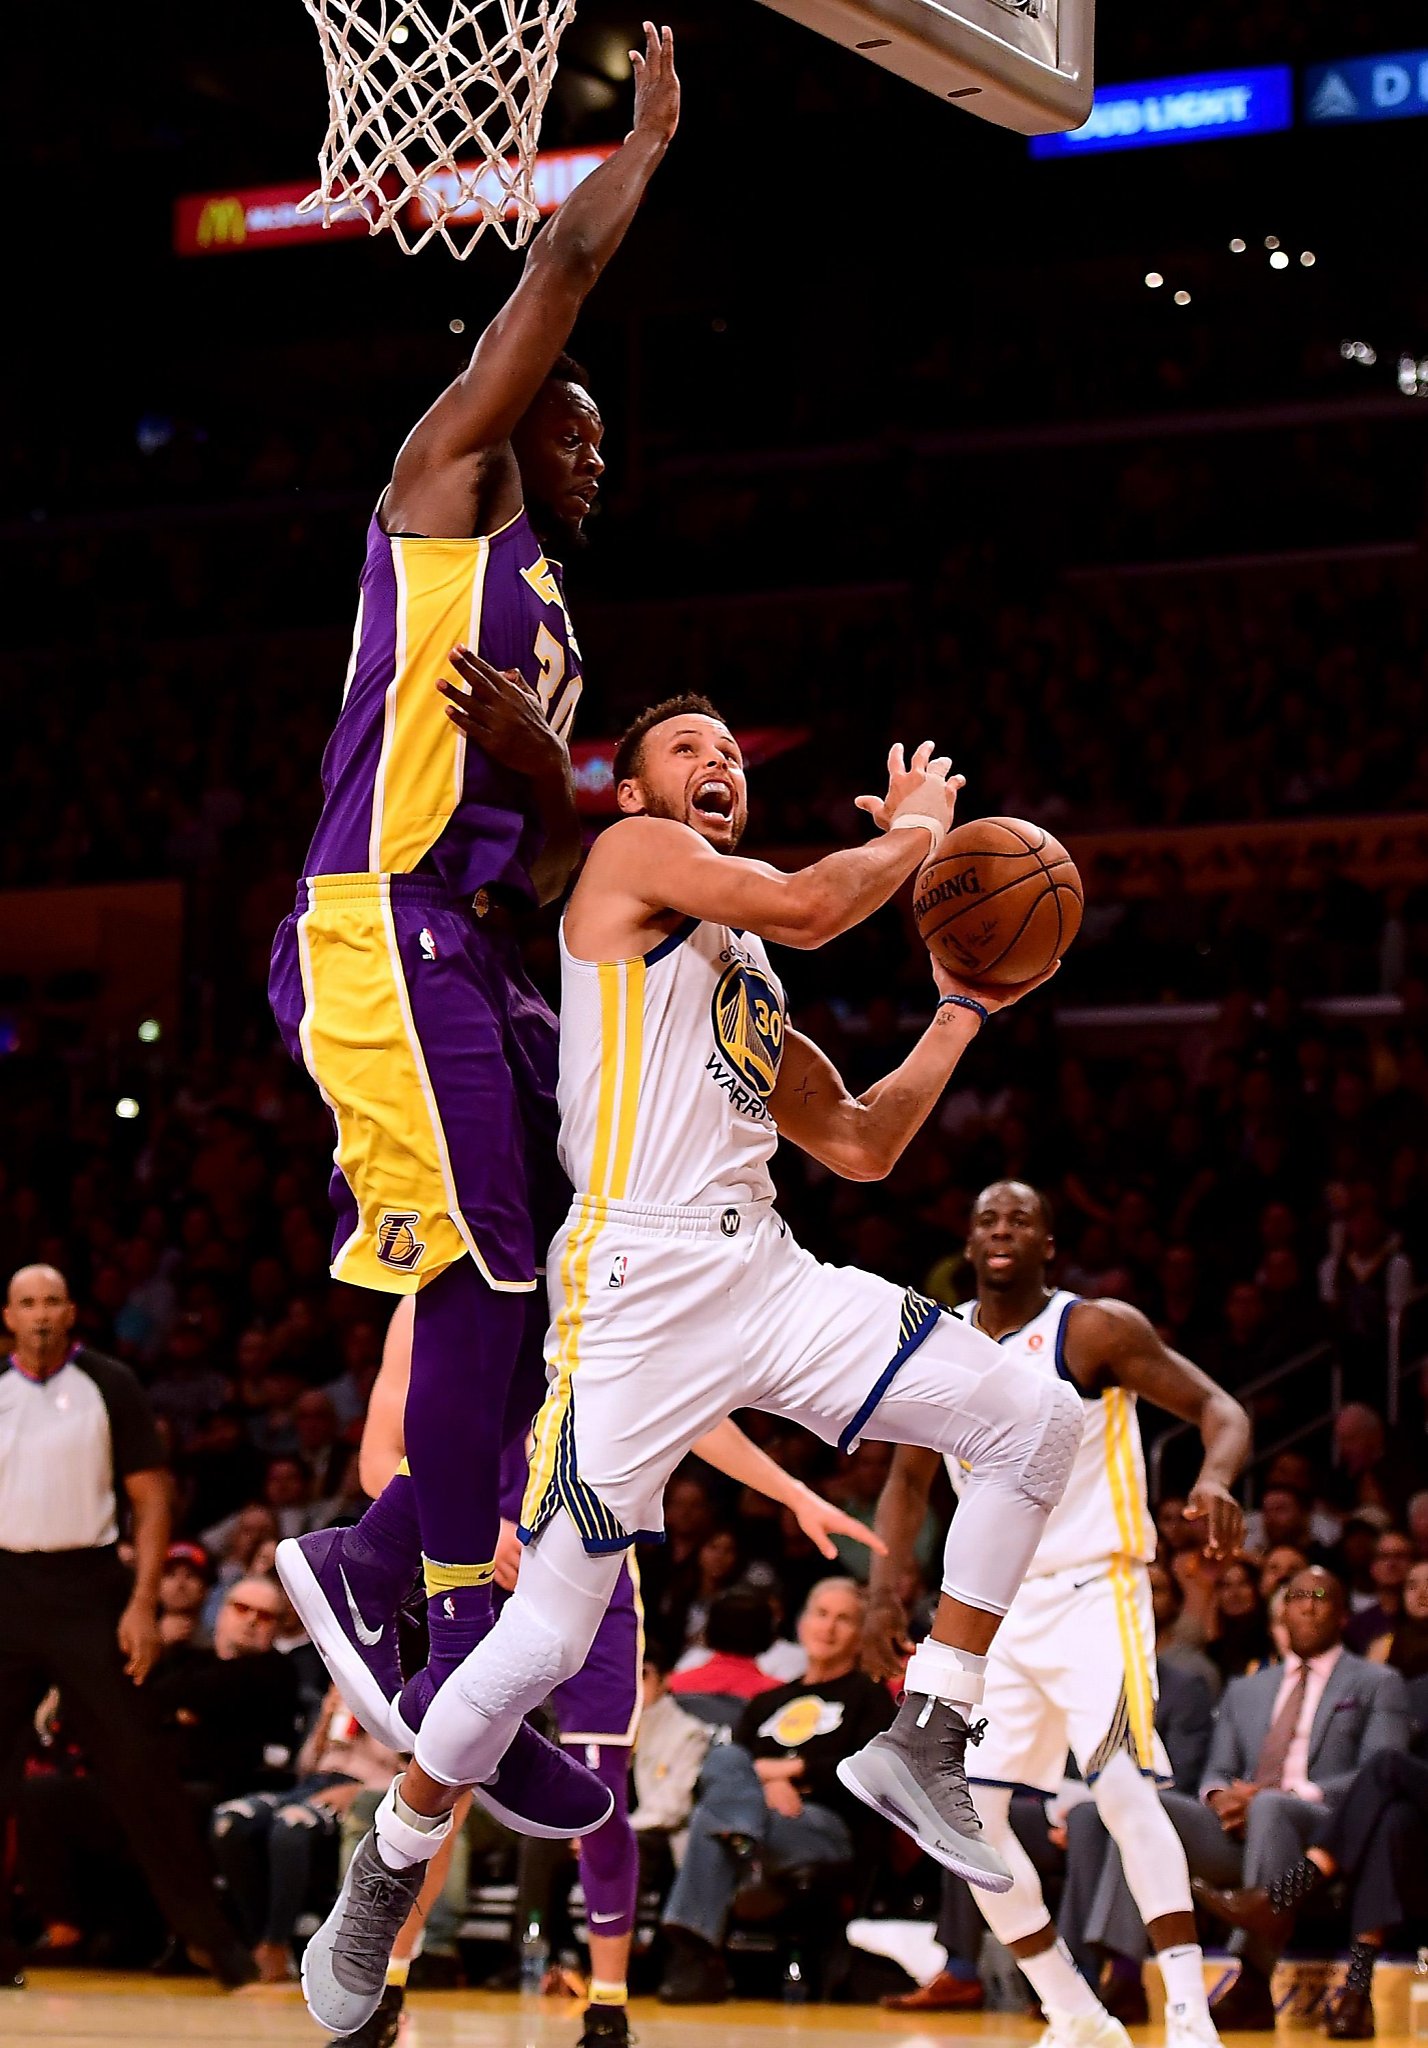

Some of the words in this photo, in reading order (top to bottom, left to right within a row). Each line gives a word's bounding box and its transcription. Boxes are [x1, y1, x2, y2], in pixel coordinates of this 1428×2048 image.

[1372, 60, 1428, 107] D
[1144, 85, 1252, 132] LIGHT
[912, 866, 980, 920] ALDING
[754, 999, 783, 1048] 30
[722, 1213, 740, 1232] W
